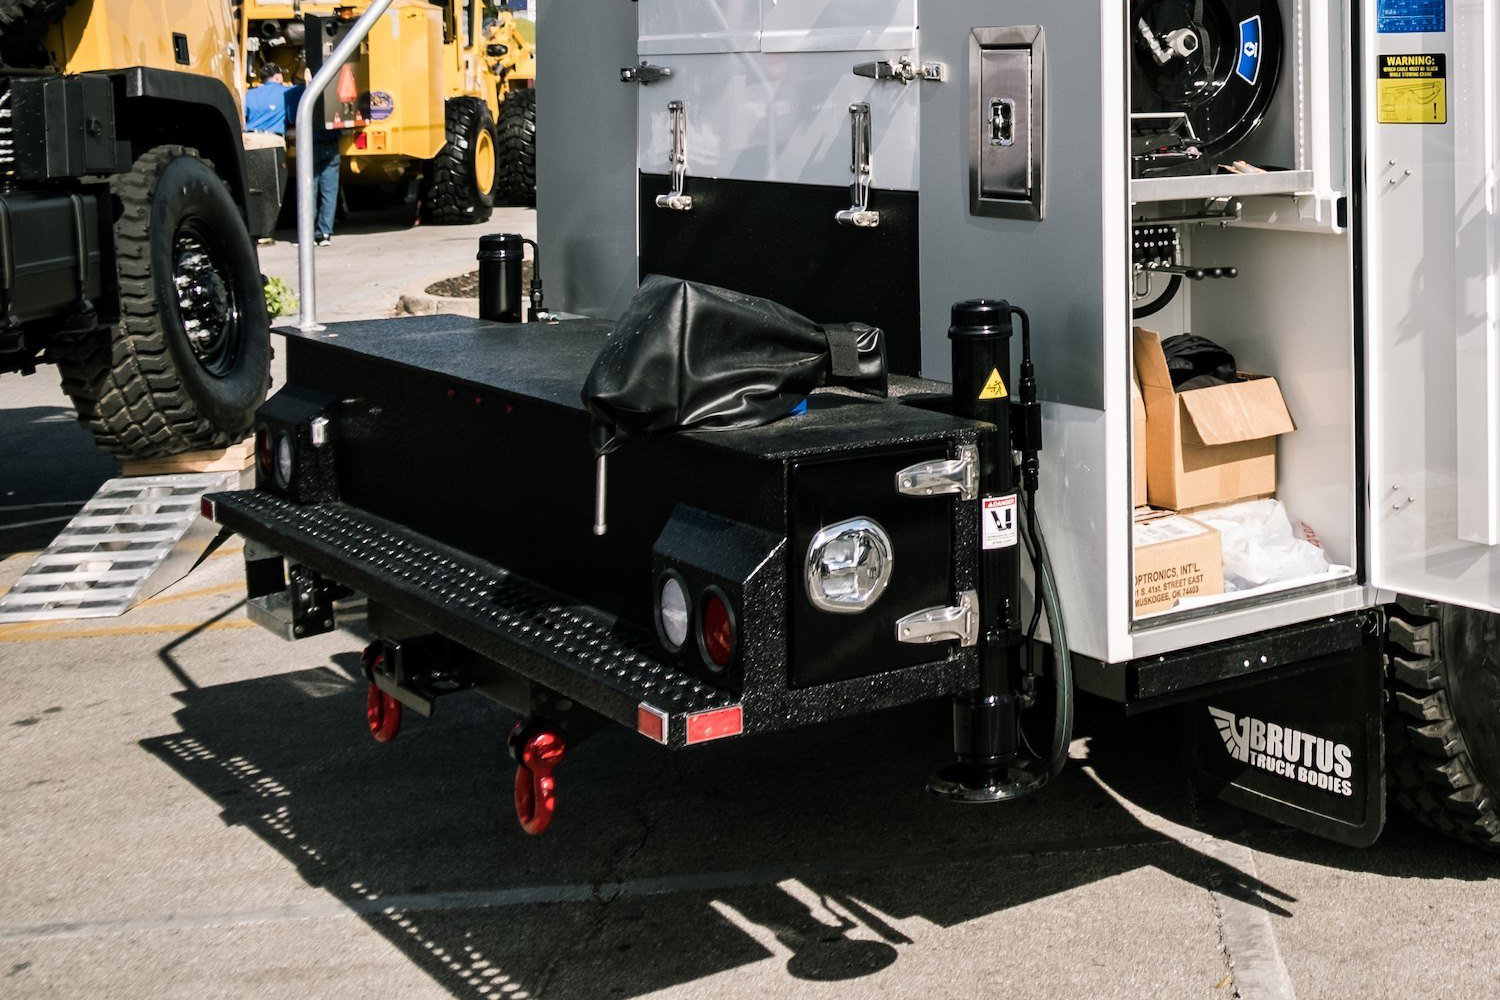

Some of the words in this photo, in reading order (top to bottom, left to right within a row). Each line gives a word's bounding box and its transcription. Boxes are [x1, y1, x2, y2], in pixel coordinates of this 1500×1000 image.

[1386, 55, 1436, 66] WARNING:
[1163, 578, 1187, 591] STREET
[1187, 574, 1204, 585] EAST
[1171, 590, 1182, 599] OK
[1250, 717, 1353, 779] BRUTUS
[1249, 750, 1296, 780] TRUCK
[1297, 765, 1353, 797] BODIES
